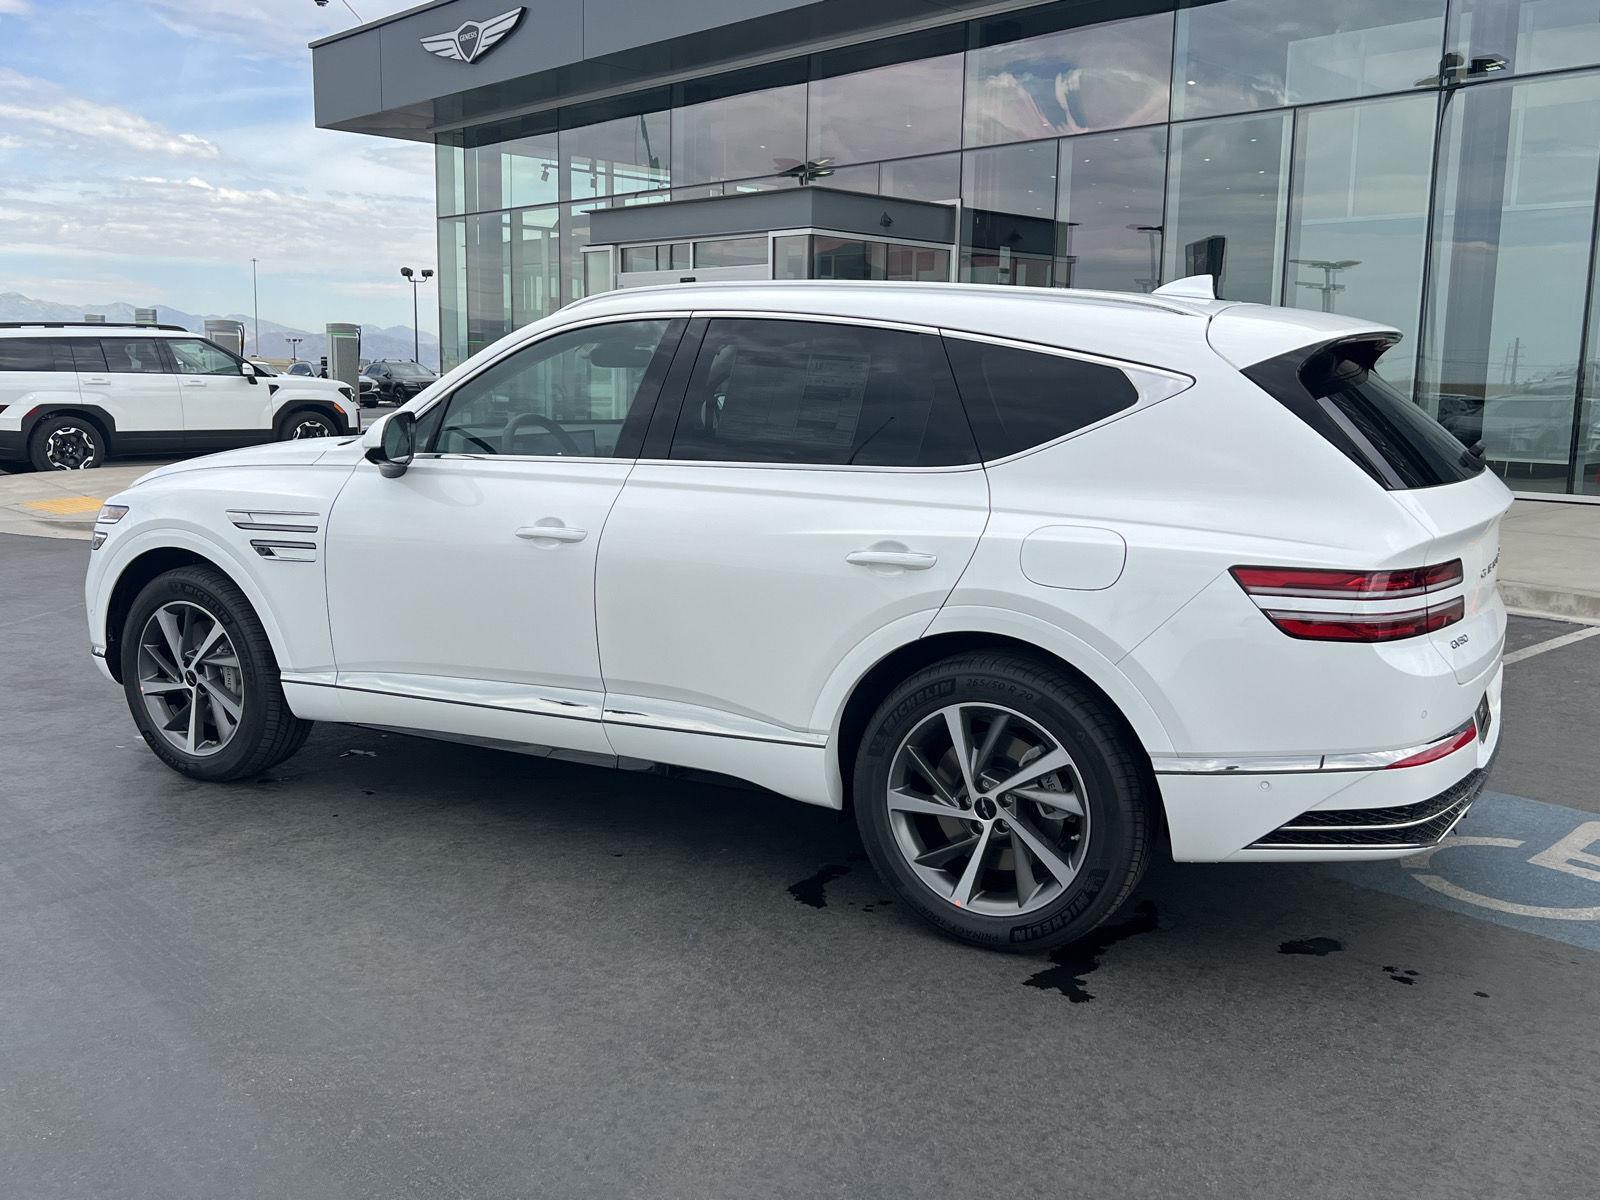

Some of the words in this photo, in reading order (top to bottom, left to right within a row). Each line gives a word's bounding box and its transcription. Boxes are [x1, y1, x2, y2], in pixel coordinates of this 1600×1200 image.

[459, 31, 478, 42] GENESIS
[882, 680, 953, 730] MICHELIN
[1007, 684, 1017, 695] R
[1019, 690, 1034, 701] 20
[1013, 892, 1090, 942] MICHELIN
